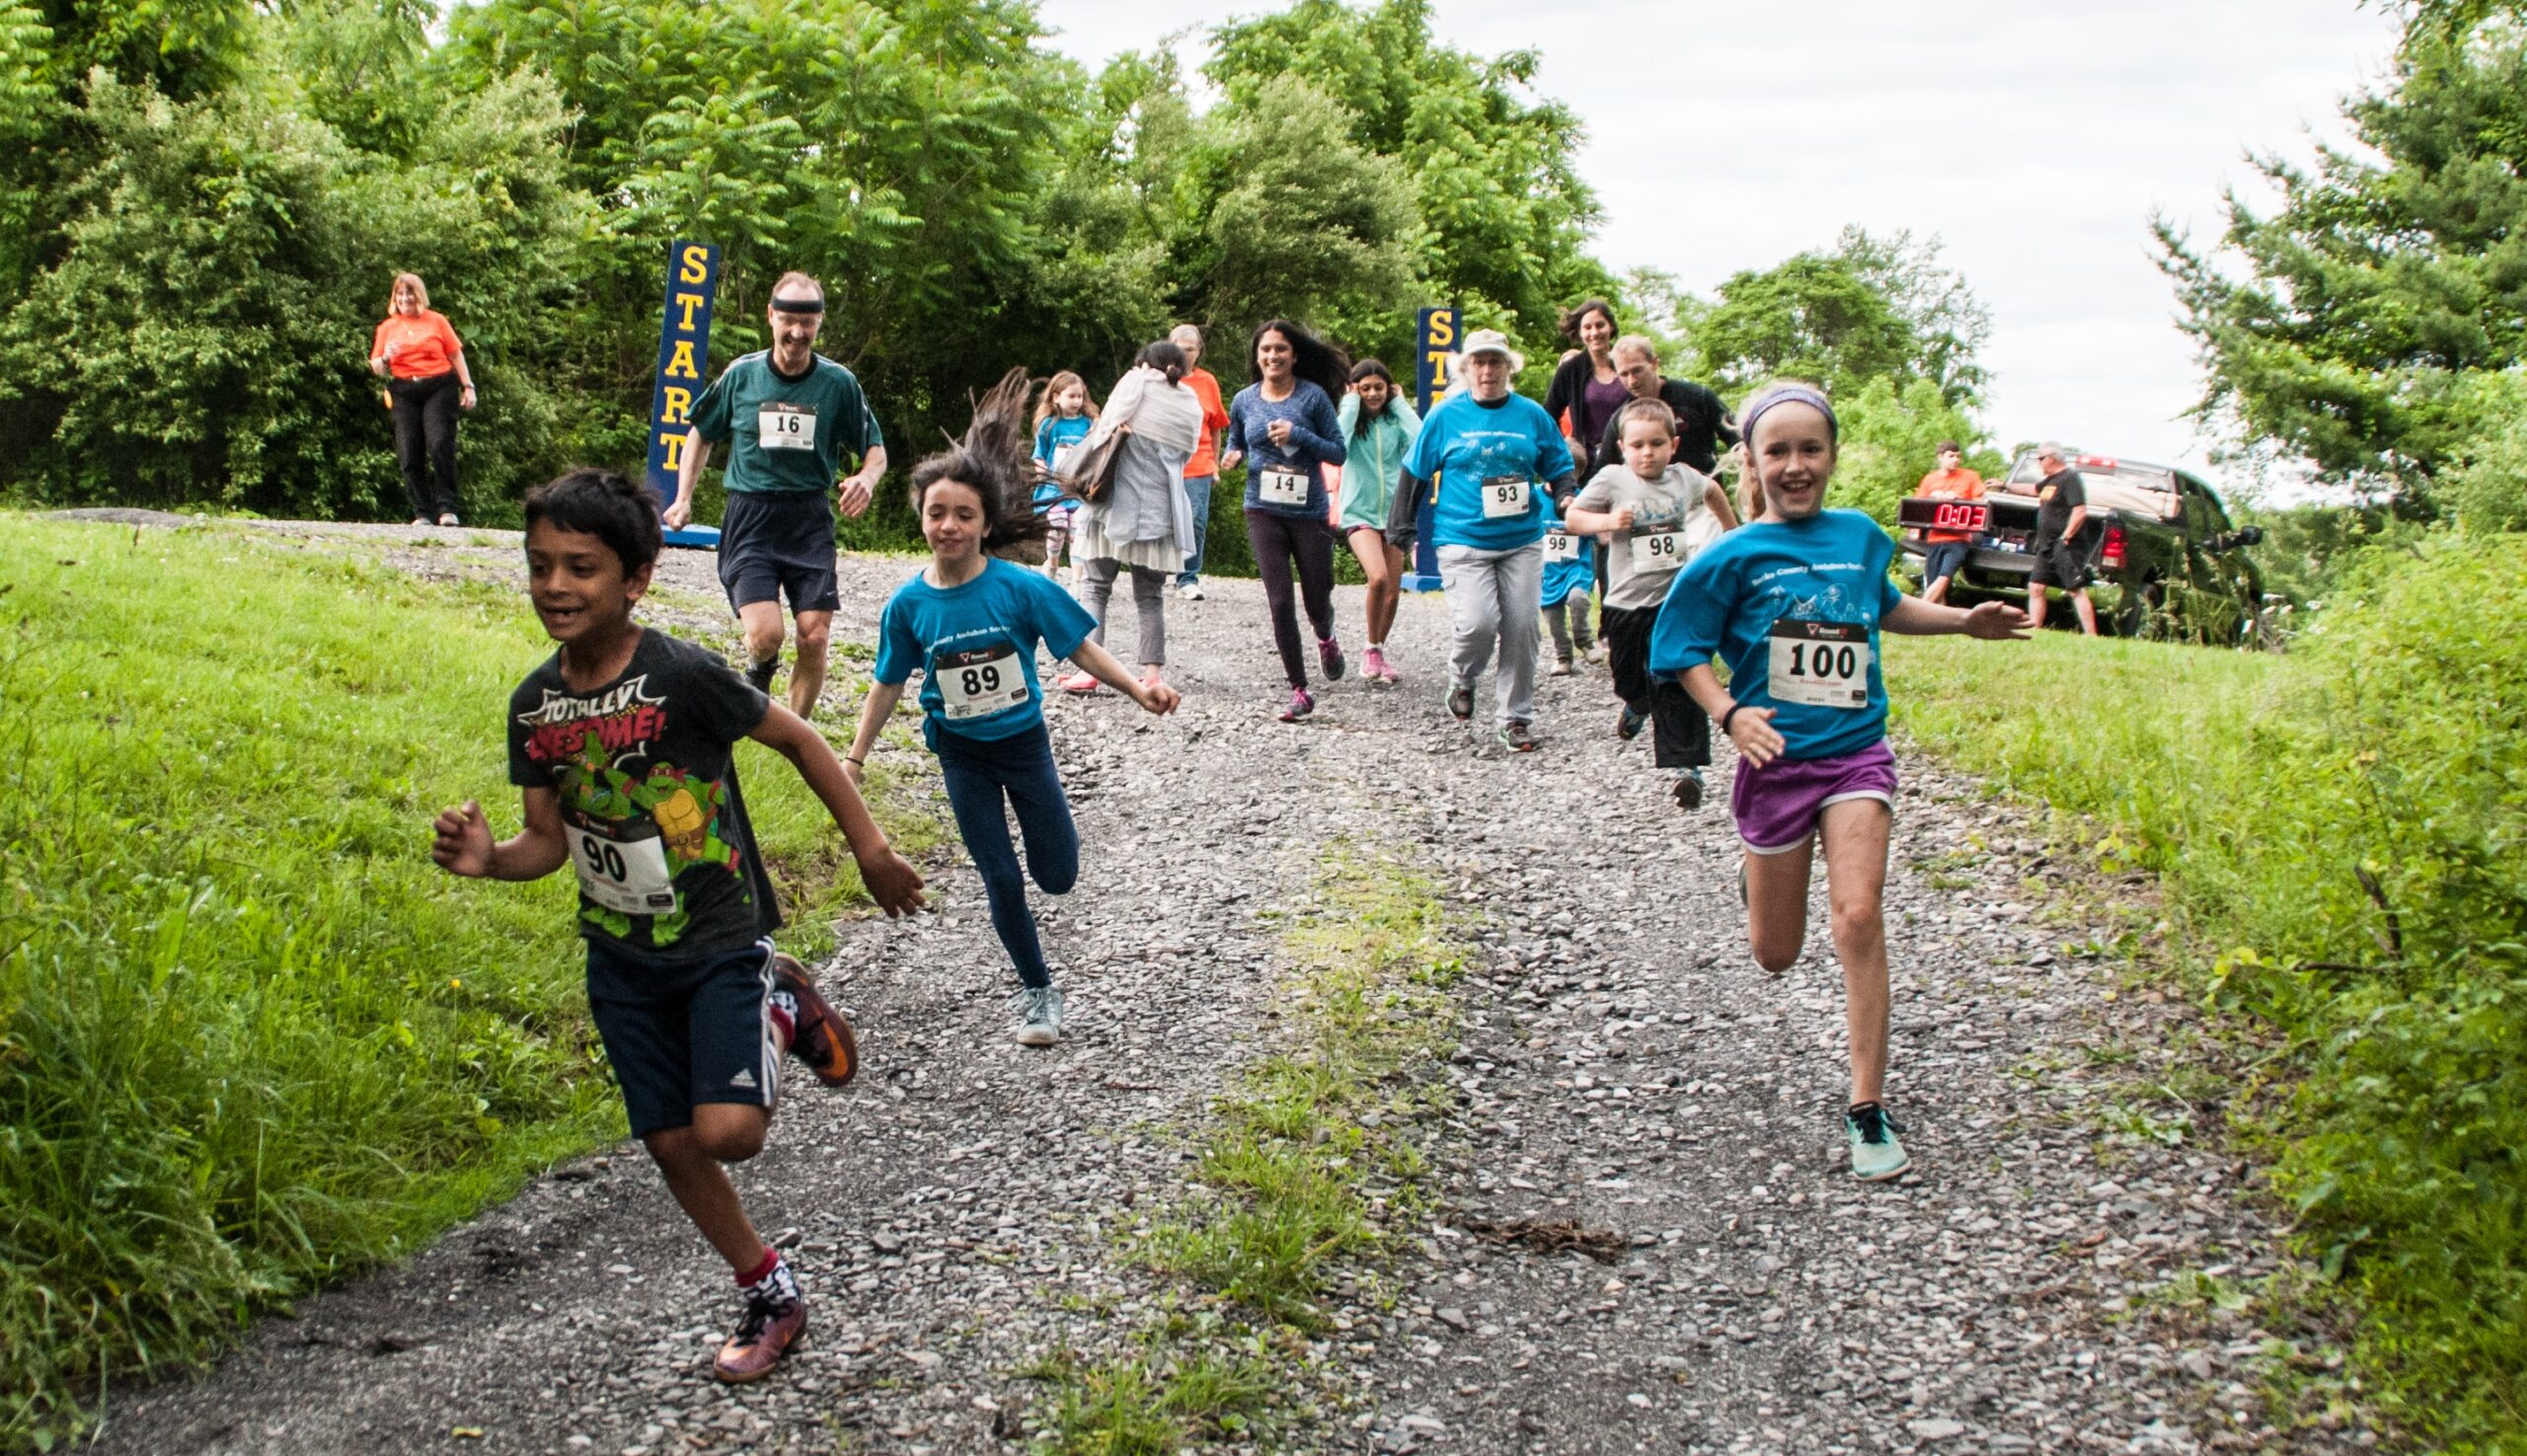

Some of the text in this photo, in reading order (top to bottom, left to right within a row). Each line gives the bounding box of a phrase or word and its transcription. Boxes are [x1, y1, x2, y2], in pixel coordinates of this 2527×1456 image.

[659, 246, 708, 470] START
[777, 415, 800, 433] 16
[1275, 475, 1294, 492] 14
[1497, 486, 1518, 503] 93
[1939, 503, 1988, 528] 0:03
[1549, 537, 1567, 551] 99
[1649, 535, 1675, 556] 98
[1789, 642, 1857, 679] 100
[961, 665, 1000, 695] 89
[544, 684, 637, 723] TOTALLY
[582, 835, 627, 882] 90
